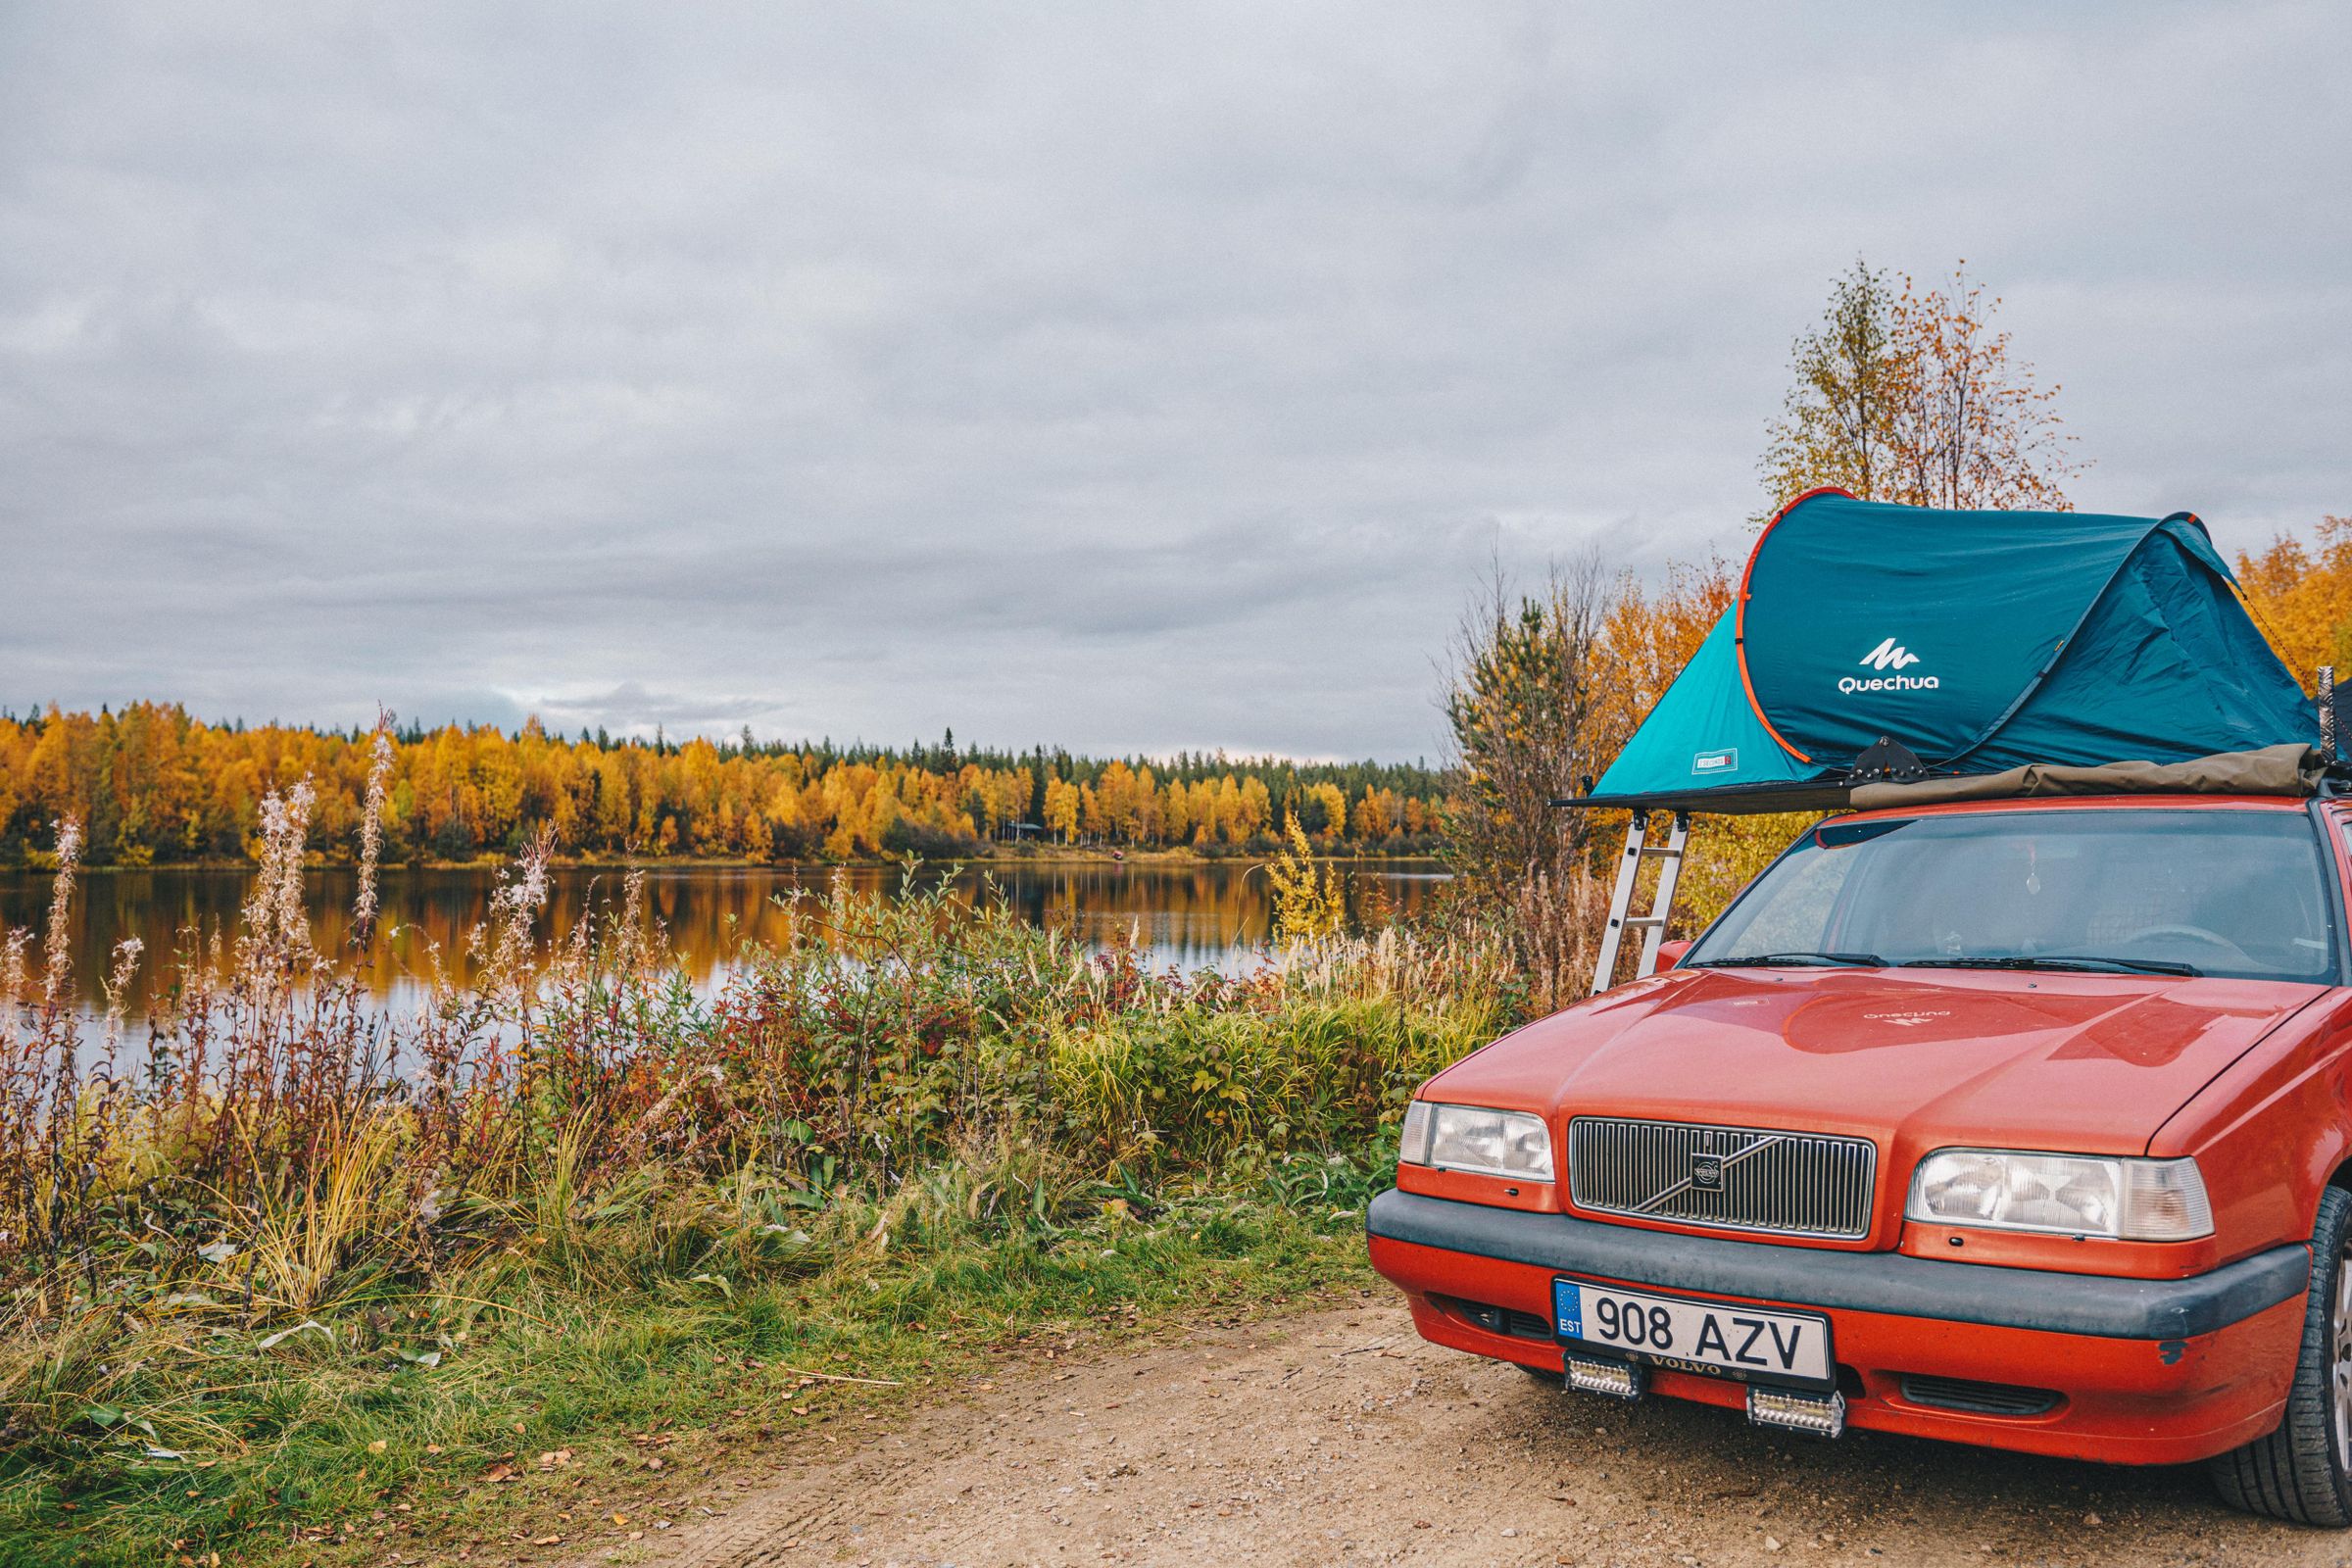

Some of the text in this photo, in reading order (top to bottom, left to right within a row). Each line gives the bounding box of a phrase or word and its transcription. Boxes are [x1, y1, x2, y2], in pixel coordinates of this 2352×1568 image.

[1838, 674, 1939, 695] Quechua
[1560, 1318, 1582, 1334] EST
[1596, 1297, 1802, 1370] 908 AZV
[1649, 1354, 1721, 1375] VOLVO
